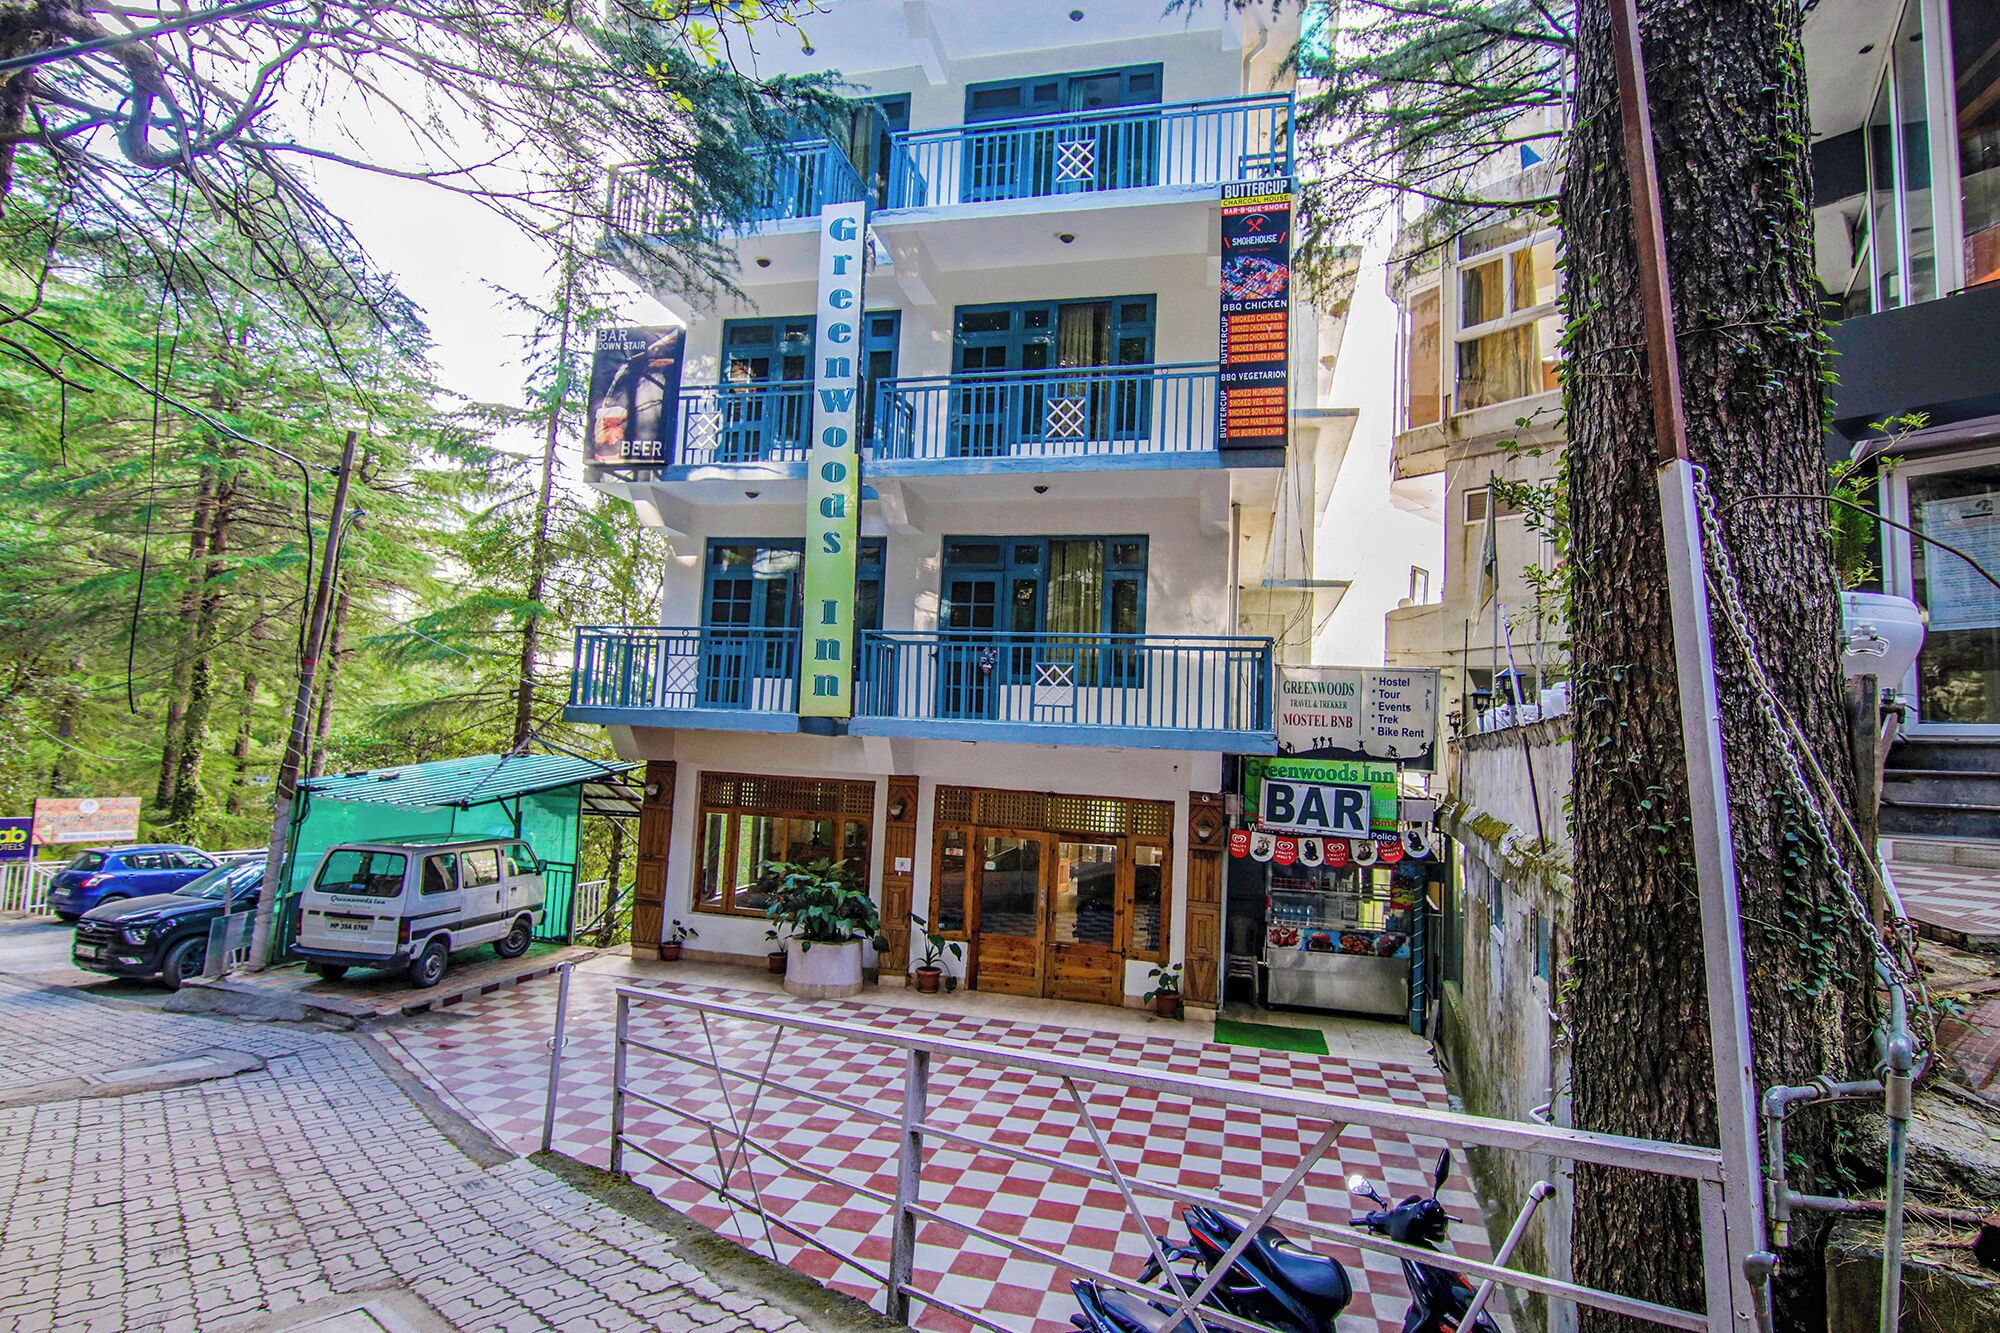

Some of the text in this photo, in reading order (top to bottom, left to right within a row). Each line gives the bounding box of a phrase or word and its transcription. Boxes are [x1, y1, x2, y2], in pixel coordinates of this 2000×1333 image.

[1224, 180, 1288, 198] BUTTERCUP
[1223, 198, 1261, 206] CHARCOAL
[1222, 300, 1288, 312] BBQ CHICKEN
[1232, 314, 1282, 323] SMOKED CHICKEN
[597, 330, 627, 342] BAR
[598, 341, 646, 350] DOWN STAIR
[1232, 344, 1254, 352] SMOKED
[1254, 343, 1267, 351] FISH
[1221, 371, 1286, 382] BBQ VEGETARION
[1230, 390, 1252, 398] SMOKED
[1230, 399, 1252, 407] SMOKED
[1228, 409, 1250, 417] SMOKED
[621, 441, 662, 456] BEER
[813, 217, 858, 697] Greenwoods Inn
[1379, 677, 1410, 687] Hostel
[1283, 681, 1354, 696] GREENWOODS
[1379, 690, 1400, 699] Tour
[1290, 699, 1312, 708] TRAVEL
[1320, 700, 1348, 710] TREKKER
[1378, 702, 1411, 712] Events
[1283, 714, 1353, 728] MOSTEL BNB
[1378, 714, 1398, 724] Trek
[1378, 726, 1424, 738] Bike Rent
[1246, 760, 1394, 784] Greenwoods Inn
[1266, 784, 1364, 830] BAR
[1371, 832, 1398, 842] Police
